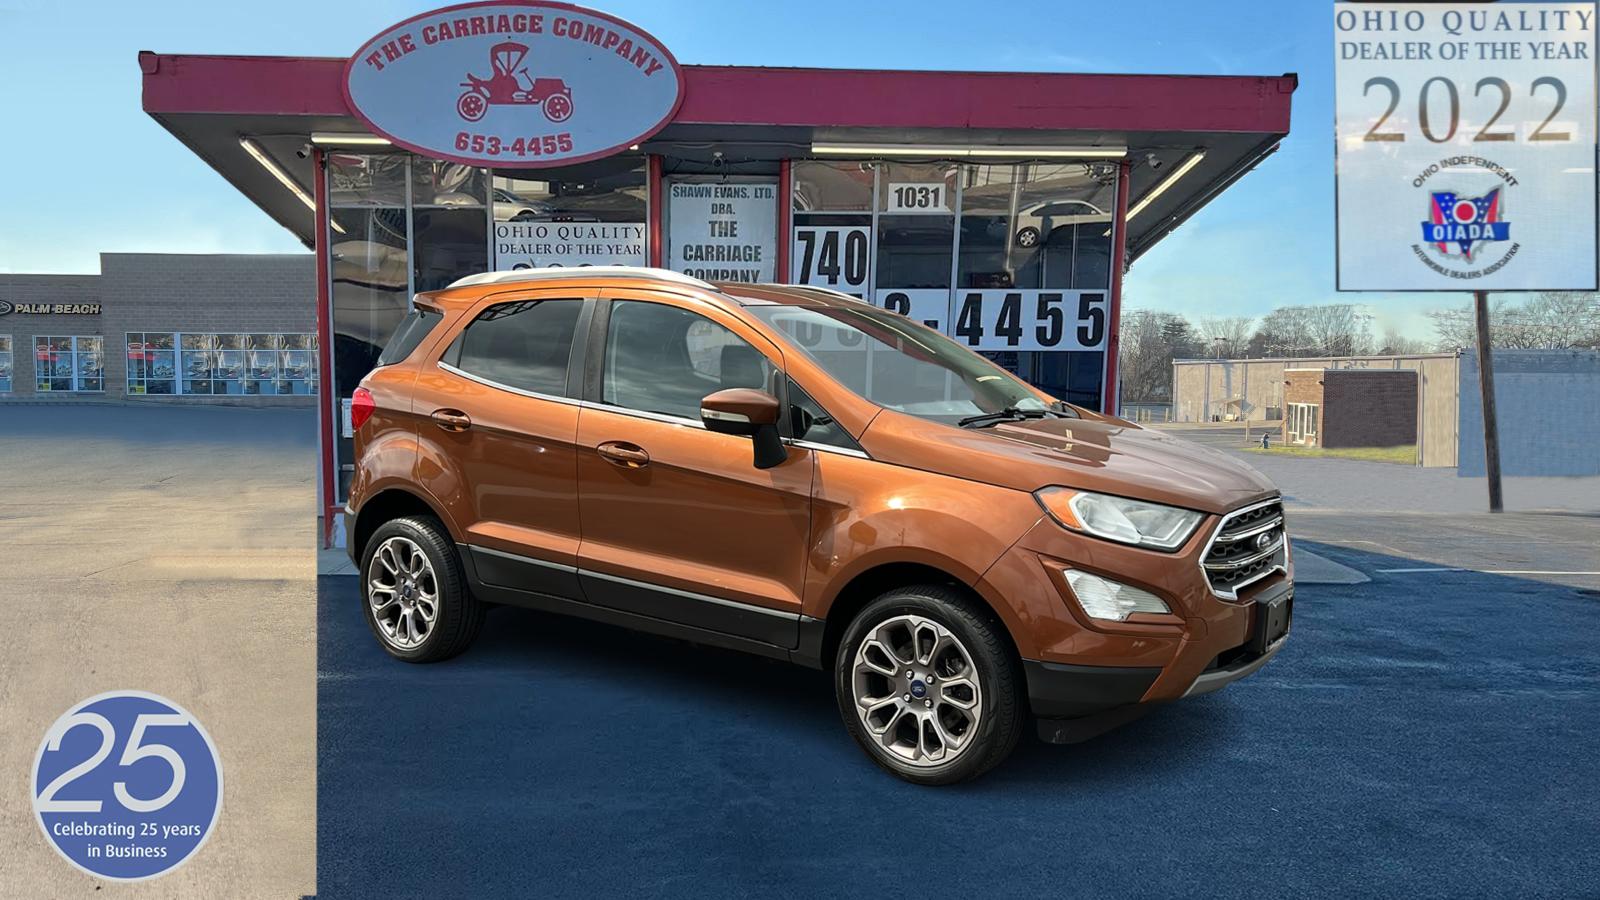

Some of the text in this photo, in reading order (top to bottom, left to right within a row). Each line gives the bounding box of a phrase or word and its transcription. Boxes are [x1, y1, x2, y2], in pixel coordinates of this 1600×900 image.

[1337, 10, 1592, 36] OHIO QUALITY
[366, 15, 663, 77] THE CARRIAGE COMPANY
[1340, 42, 1589, 60] DEALER OF THE YEAR
[1363, 76, 1571, 143] 2022
[455, 132, 573, 156] 653-4455
[1412, 156, 1519, 188] OHIO INDEPENDENT
[673, 186, 711, 198] SHAWN
[894, 187, 940, 208] 1031
[711, 203, 736, 215] DBA.
[497, 226, 644, 241] OHIO QUALITY
[708, 221, 738, 238] THE
[1432, 224, 1495, 241] OIADA
[499, 243, 641, 255] DEALER OF THE YEAR
[683, 244, 762, 262] CARRIAGE
[797, 230, 867, 285] 740
[15, 303, 51, 314] PALM
[54, 303, 100, 314] BEACH
